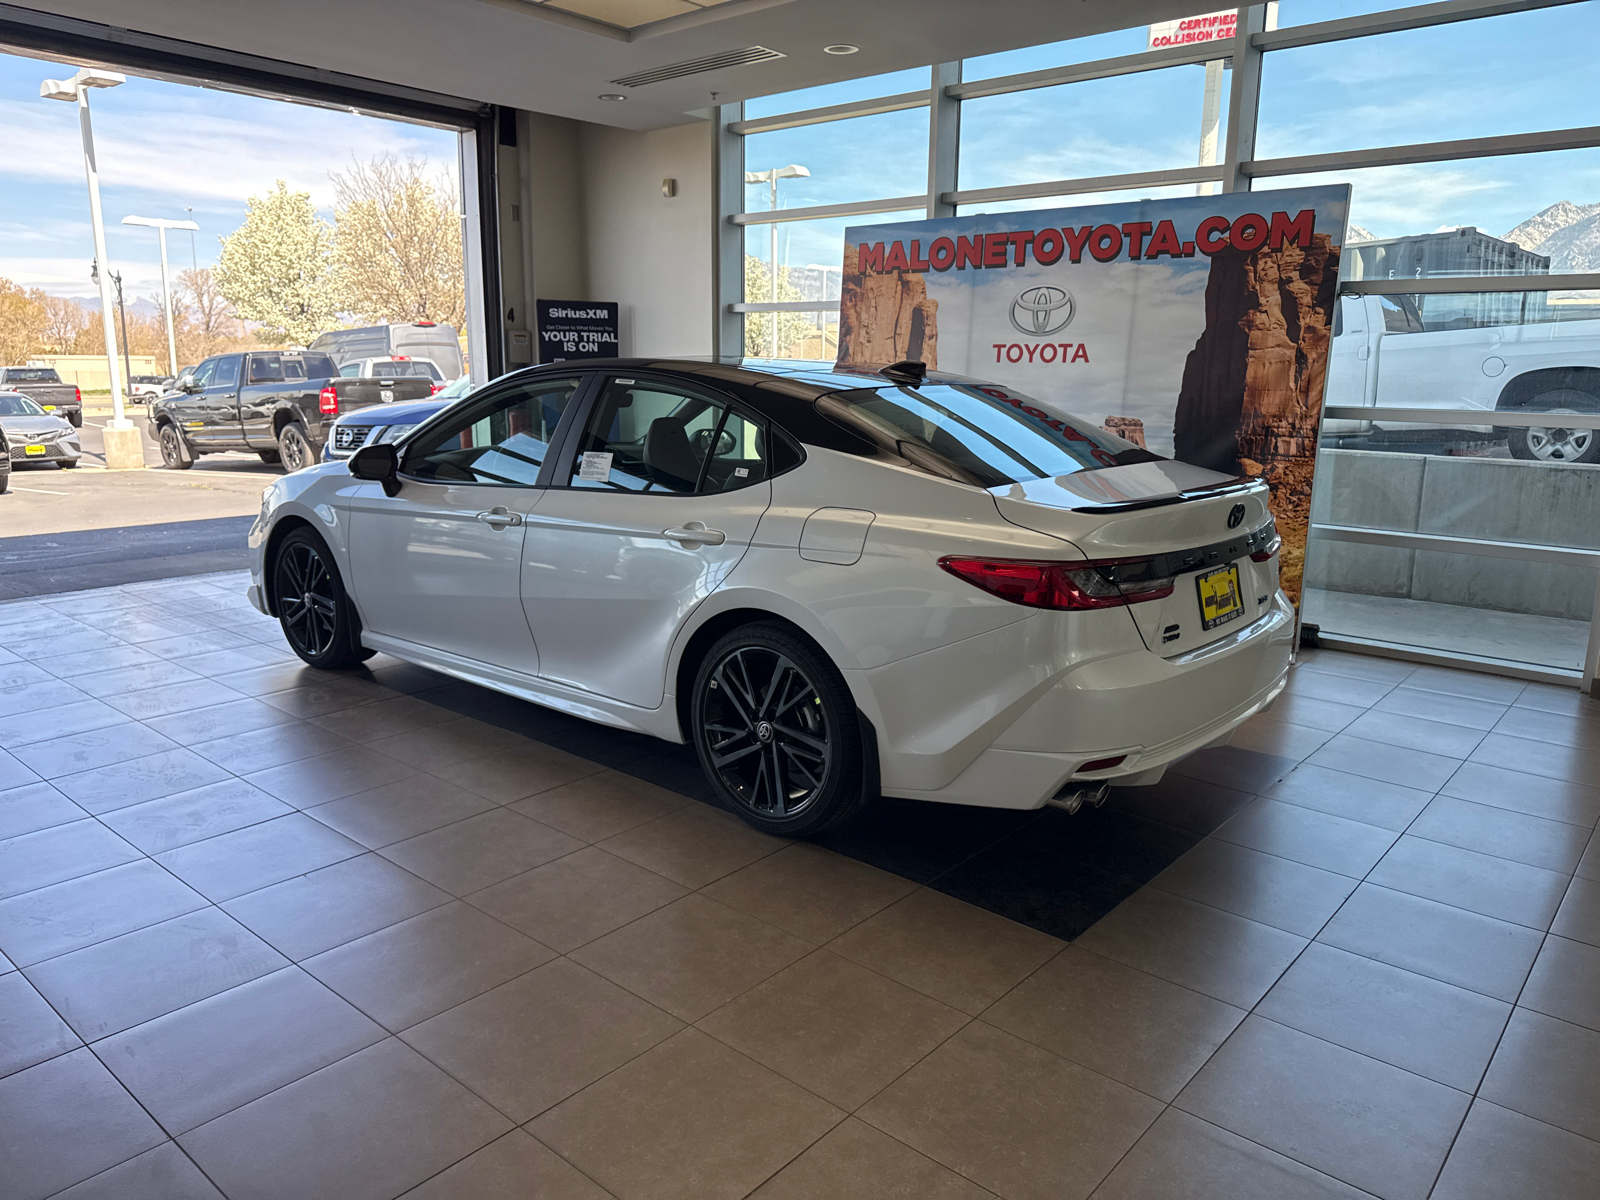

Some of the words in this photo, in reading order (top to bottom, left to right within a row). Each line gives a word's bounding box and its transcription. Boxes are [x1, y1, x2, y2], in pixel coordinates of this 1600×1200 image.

[1179, 14, 1237, 31] CERTIFIED
[1152, 29, 1213, 47] COLLISION
[857, 209, 1316, 273] MALONETOYOTA.COM
[507, 307, 515, 323] 4
[548, 307, 609, 319] SiriusXM
[541, 331, 579, 342] YOUR
[580, 332, 618, 343] TRIAL
[563, 341, 577, 352] IS
[578, 342, 599, 353] ON
[993, 343, 1090, 364] TOYOTA
